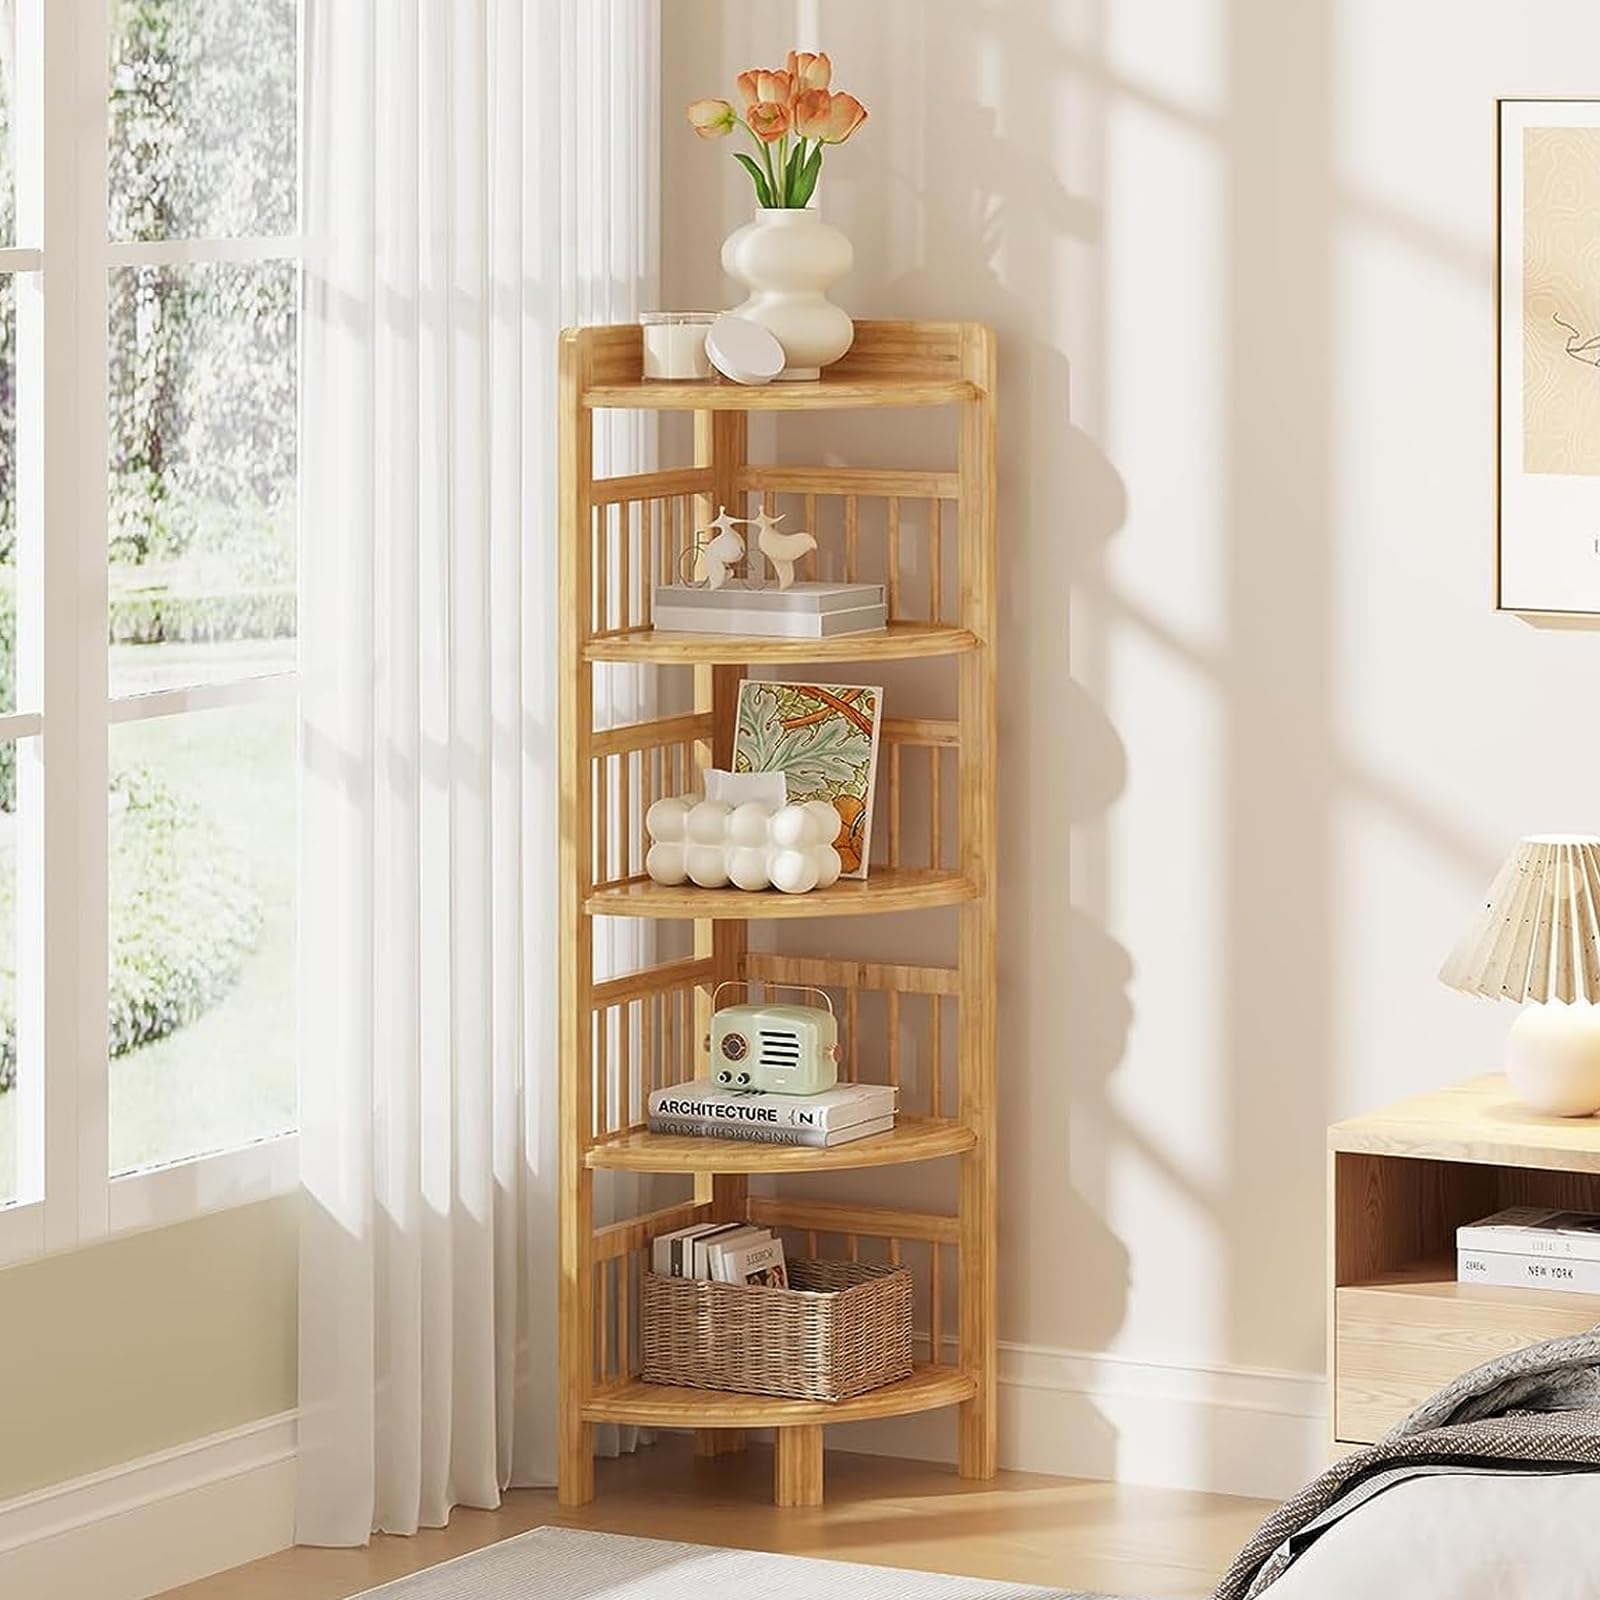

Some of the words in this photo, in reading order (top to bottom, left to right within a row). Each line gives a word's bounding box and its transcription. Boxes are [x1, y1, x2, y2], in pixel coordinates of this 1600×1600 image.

[658, 1100, 778, 1122] ARCHITECTURE
[1465, 1260, 1487, 1272] CEREAL
[1528, 1265, 1547, 1277] NEW
[1551, 1267, 1574, 1279] YORK
